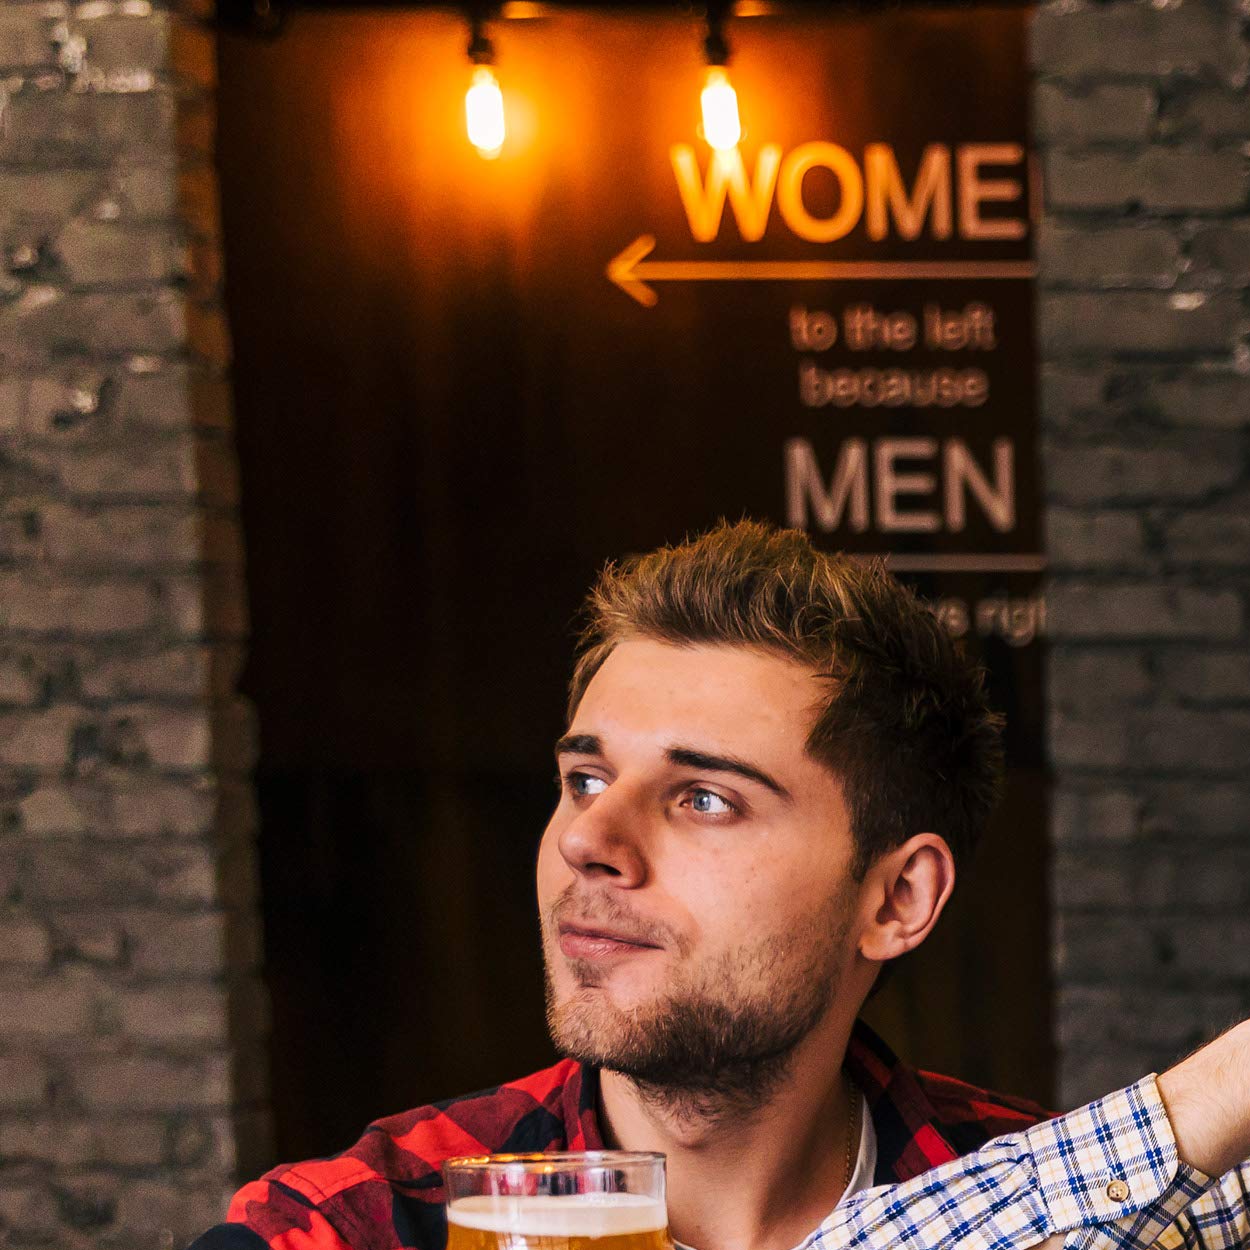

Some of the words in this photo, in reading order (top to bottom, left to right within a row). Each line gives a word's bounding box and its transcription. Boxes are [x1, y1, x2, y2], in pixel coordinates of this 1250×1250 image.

[670, 140, 1039, 242] WOME
[788, 303, 838, 349] to
[842, 303, 917, 349] the
[923, 302, 995, 350] left
[799, 361, 990, 408] because
[783, 436, 1016, 533] MEN
